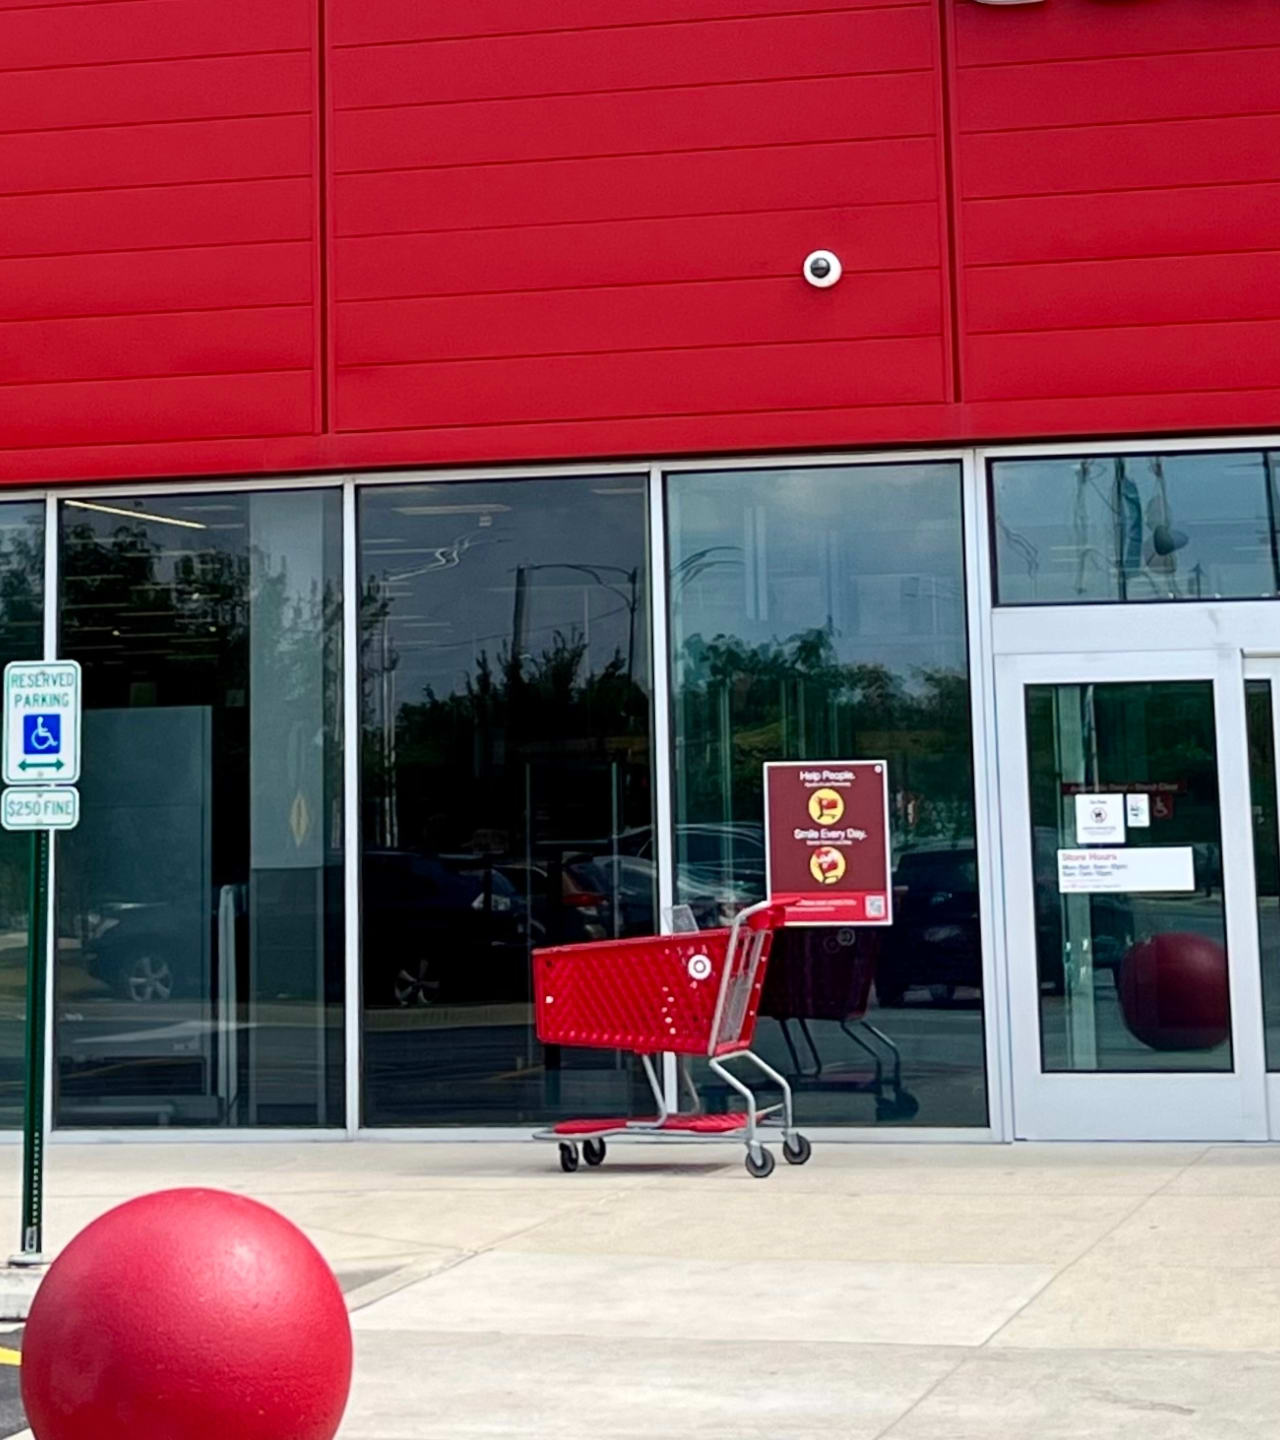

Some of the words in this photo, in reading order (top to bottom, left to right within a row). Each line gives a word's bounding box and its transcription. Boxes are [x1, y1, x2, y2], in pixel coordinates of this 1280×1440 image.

[10, 671, 74, 689] RESERVED
[14, 692, 70, 709] PARKING
[799, 770, 821, 782] Help
[7, 799, 41, 817] $250
[43, 799, 73, 816] FINE
[820, 827, 846, 841] Every
